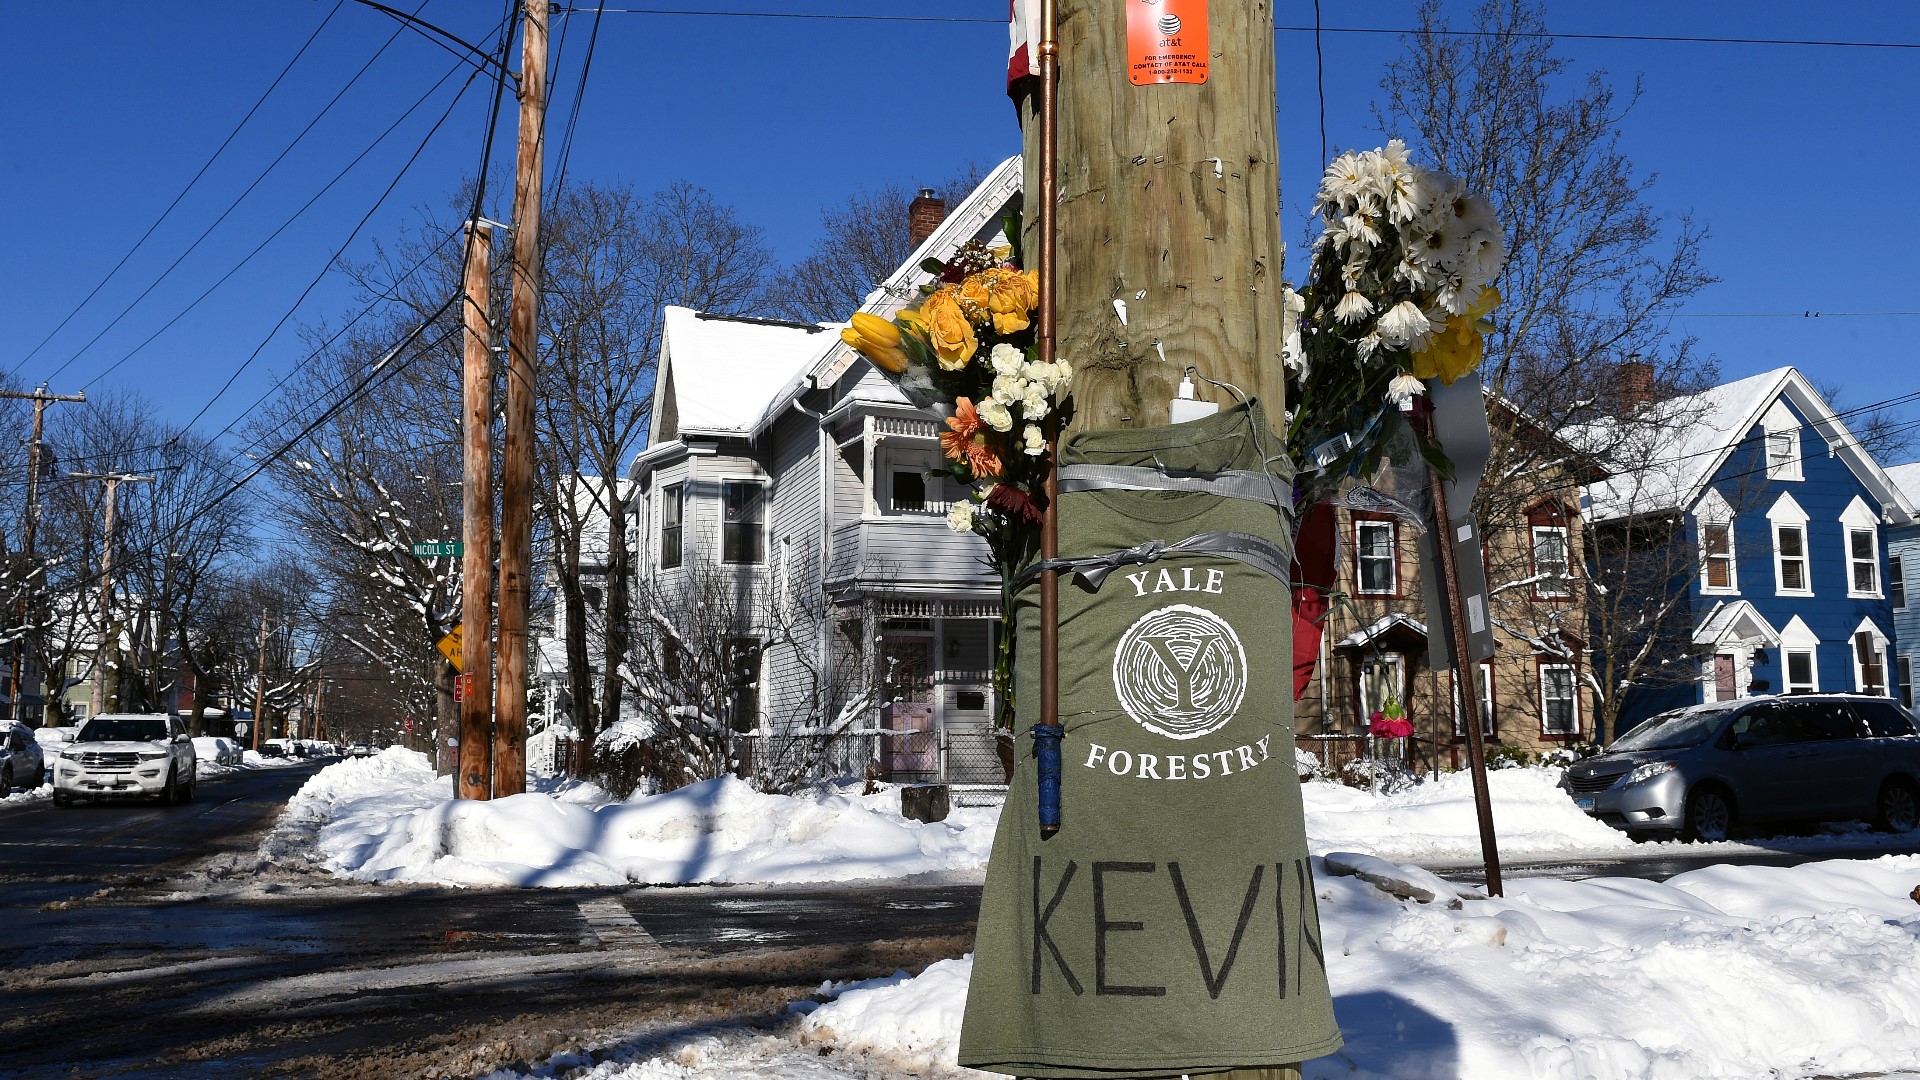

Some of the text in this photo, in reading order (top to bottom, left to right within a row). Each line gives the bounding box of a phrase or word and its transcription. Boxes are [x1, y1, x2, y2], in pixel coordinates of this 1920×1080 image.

[1159, 37, 1182, 47] at&t
[414, 544, 456, 555] NICOLL ST
[1126, 567, 1224, 597] YALE
[1083, 734, 1271, 780] FORESTRY
[1031, 855, 1326, 1000] KEVIN
